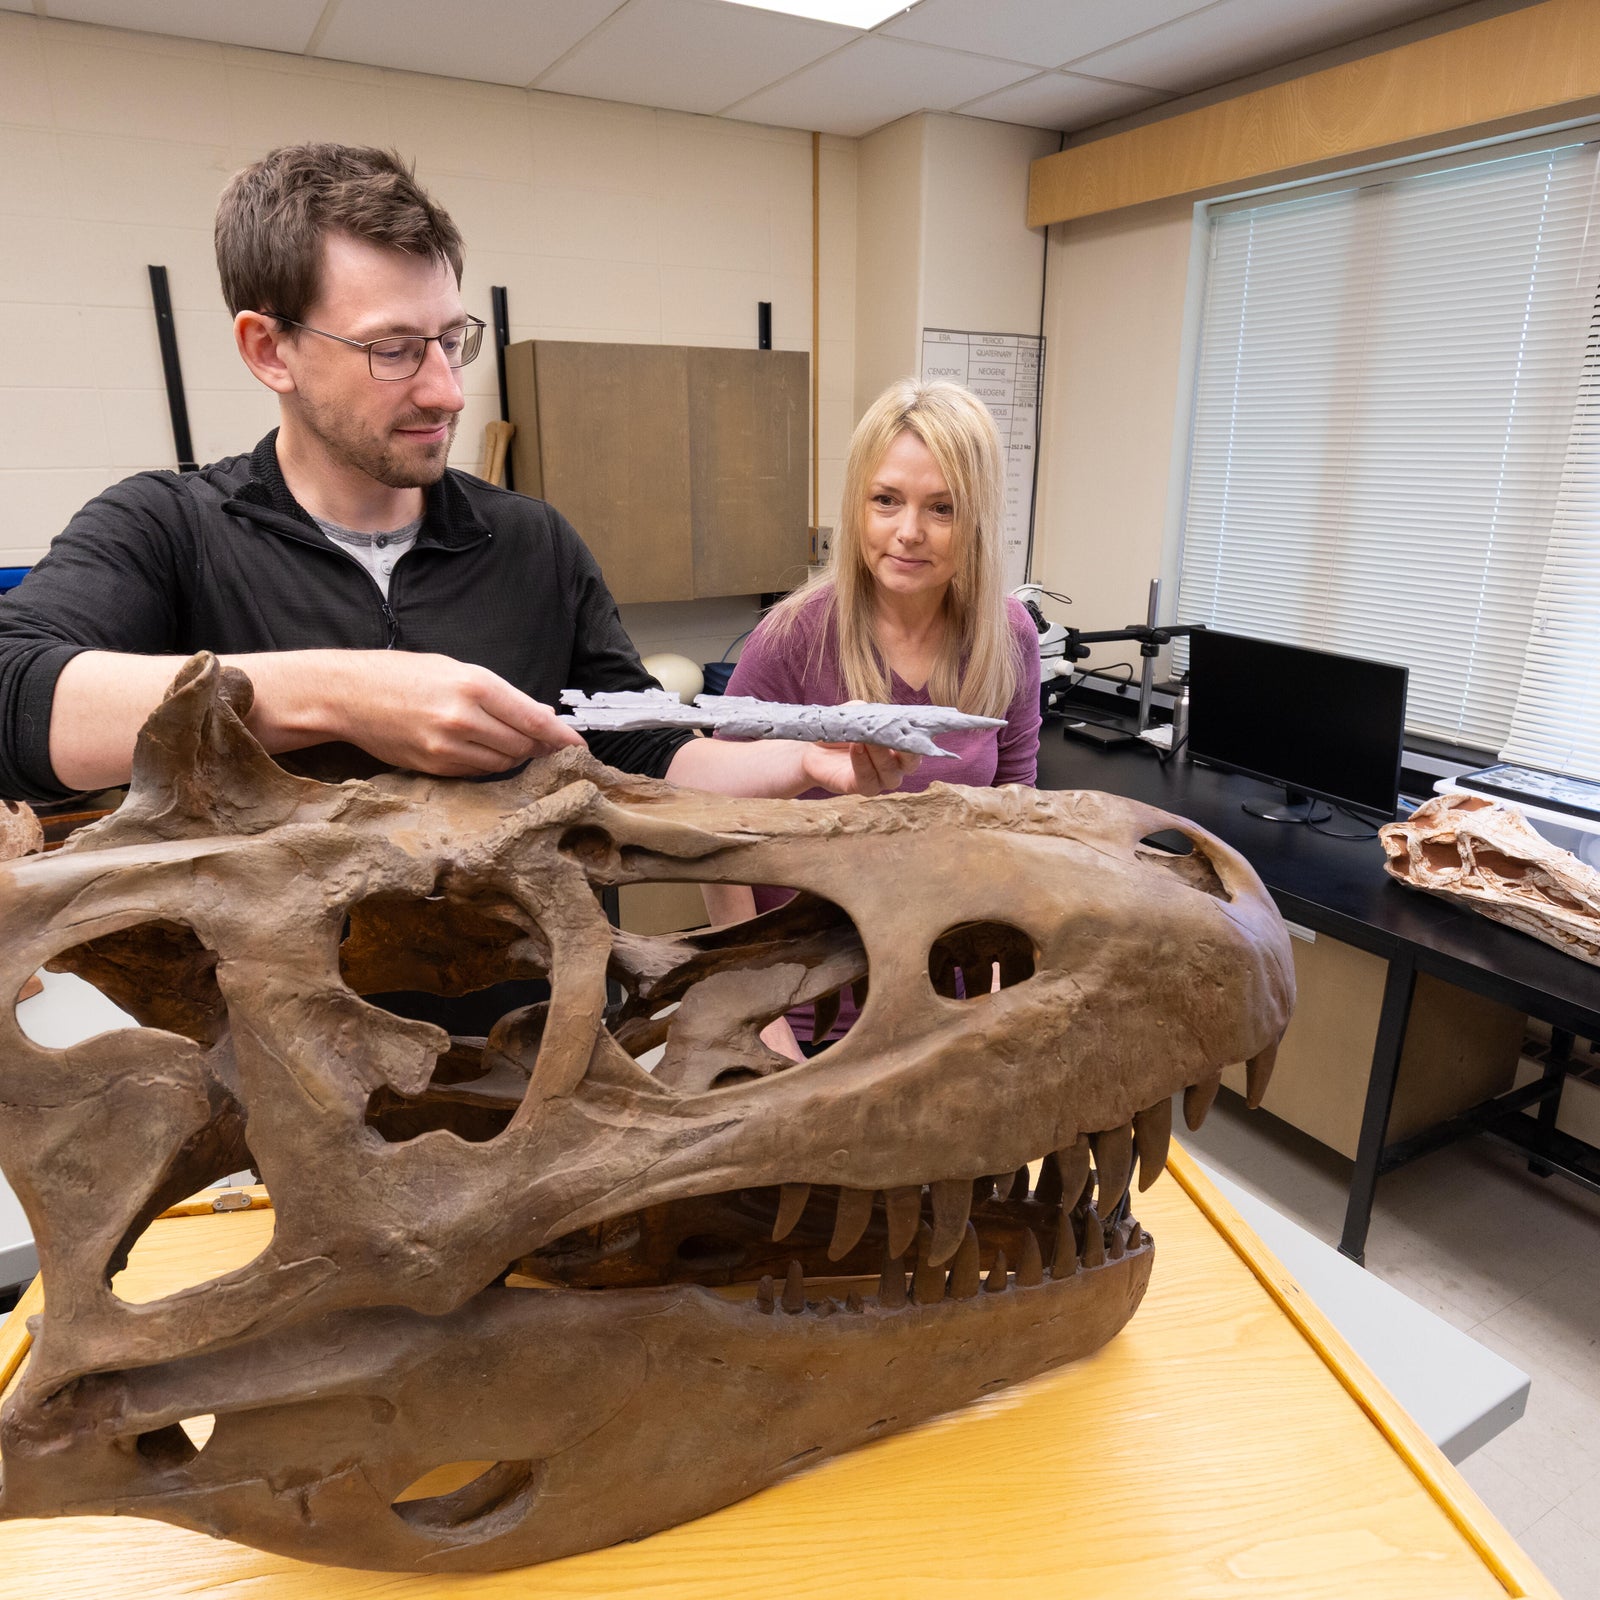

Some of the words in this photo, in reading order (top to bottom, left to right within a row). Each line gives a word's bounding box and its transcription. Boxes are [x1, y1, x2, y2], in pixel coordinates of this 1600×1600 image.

[982, 337, 1004, 345] PERIOD
[976, 349, 1012, 358] QUATERNARY
[927, 368, 961, 376] CENOZOIC
[978, 368, 1006, 376] NEOGENE
